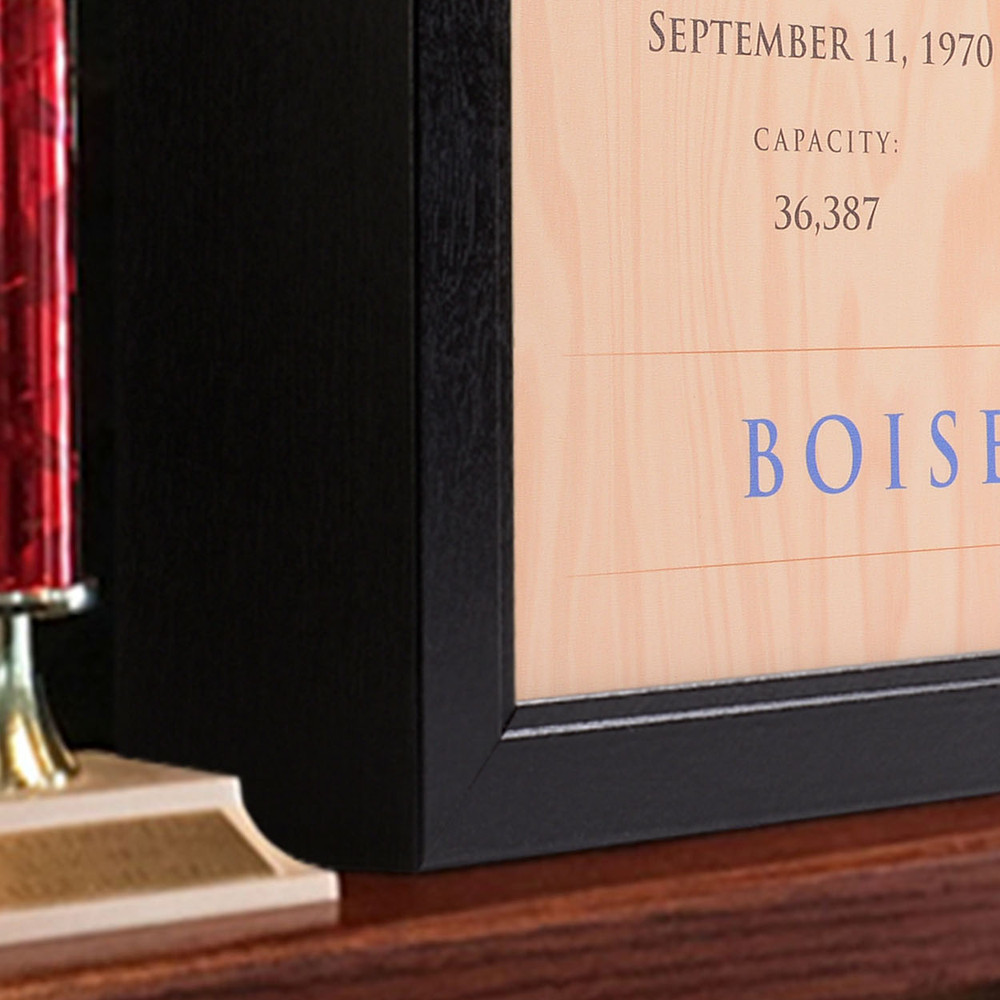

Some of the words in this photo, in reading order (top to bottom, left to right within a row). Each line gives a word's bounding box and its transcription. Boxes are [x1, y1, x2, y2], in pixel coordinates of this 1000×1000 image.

[648, 10, 854, 62] SEPTEMBER
[864, 28, 908, 69] 11,
[922, 30, 994, 68] 1970
[753, 127, 899, 154] CAPACITY:
[774, 194, 881, 236] 36,387
